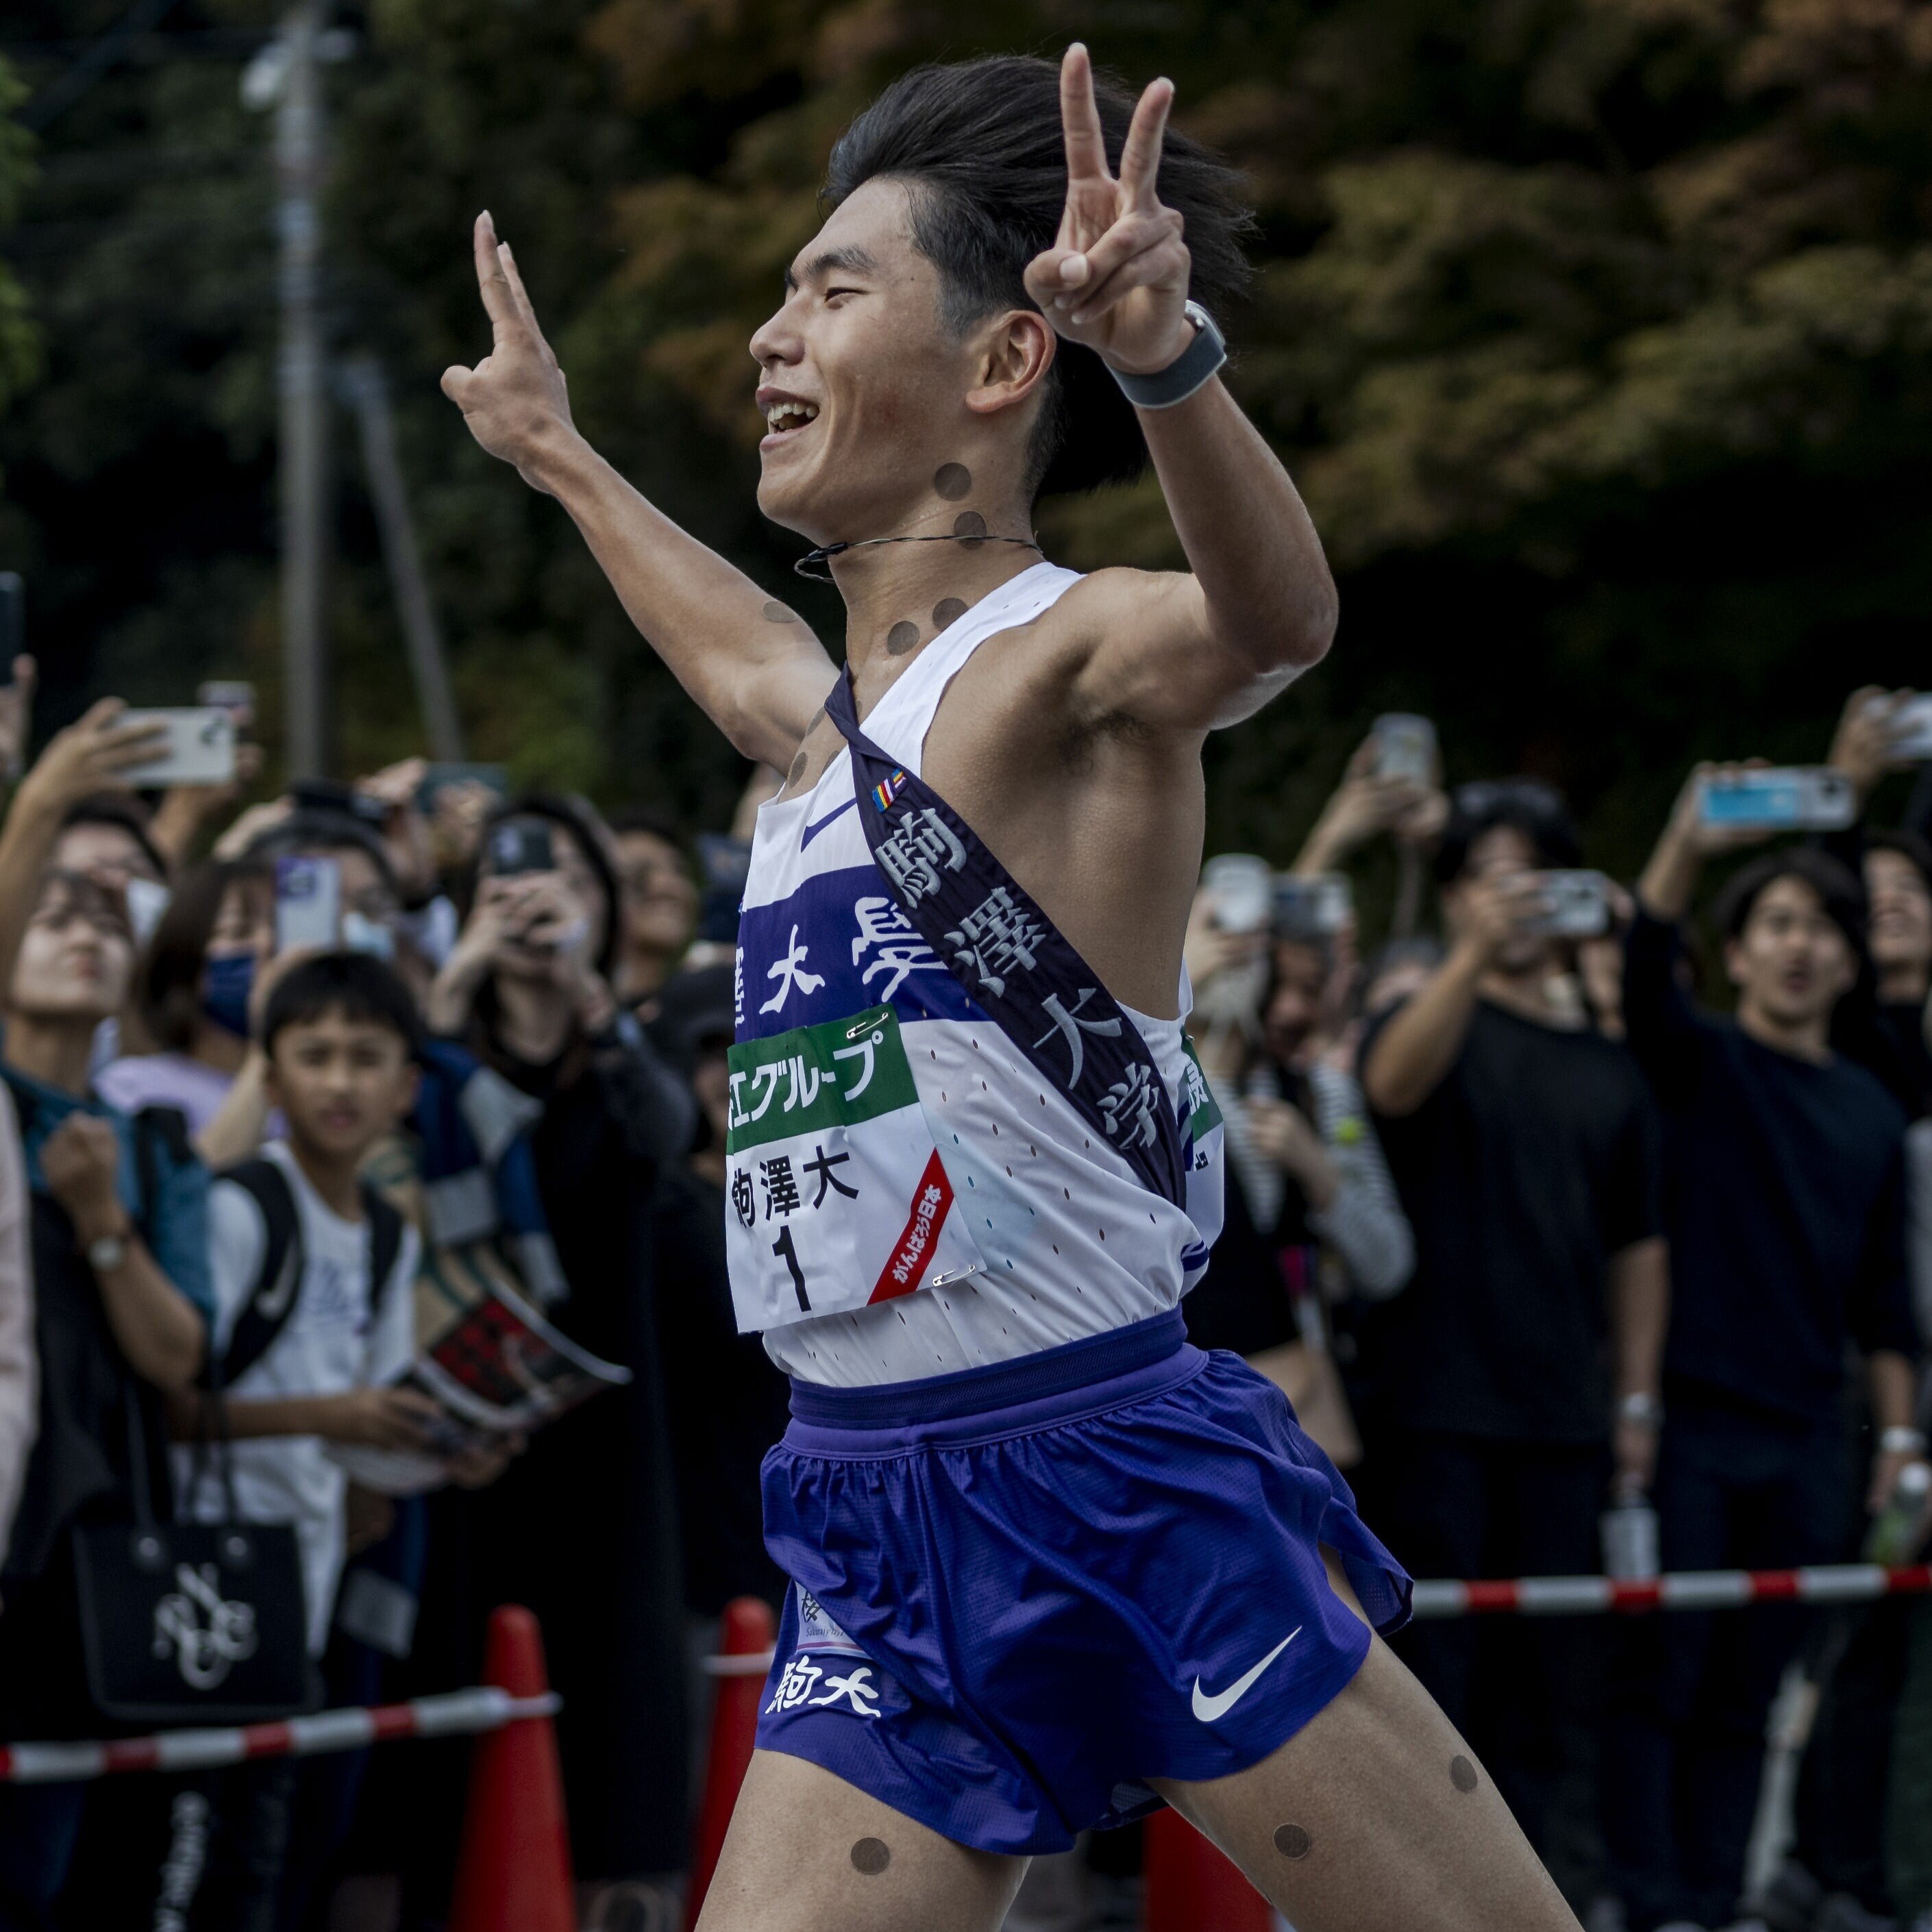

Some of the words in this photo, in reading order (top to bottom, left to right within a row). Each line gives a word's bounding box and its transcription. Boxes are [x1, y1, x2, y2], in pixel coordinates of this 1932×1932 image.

[735, 896, 950, 1028] 大學
[876, 808, 1159, 1149] 駒澤大学
[728, 1030, 883, 1130] 工グループ
[772, 1225, 812, 1312] 1
[892, 1184, 941, 1283] がんばろう日本
[765, 1655, 881, 1718] 駒大
